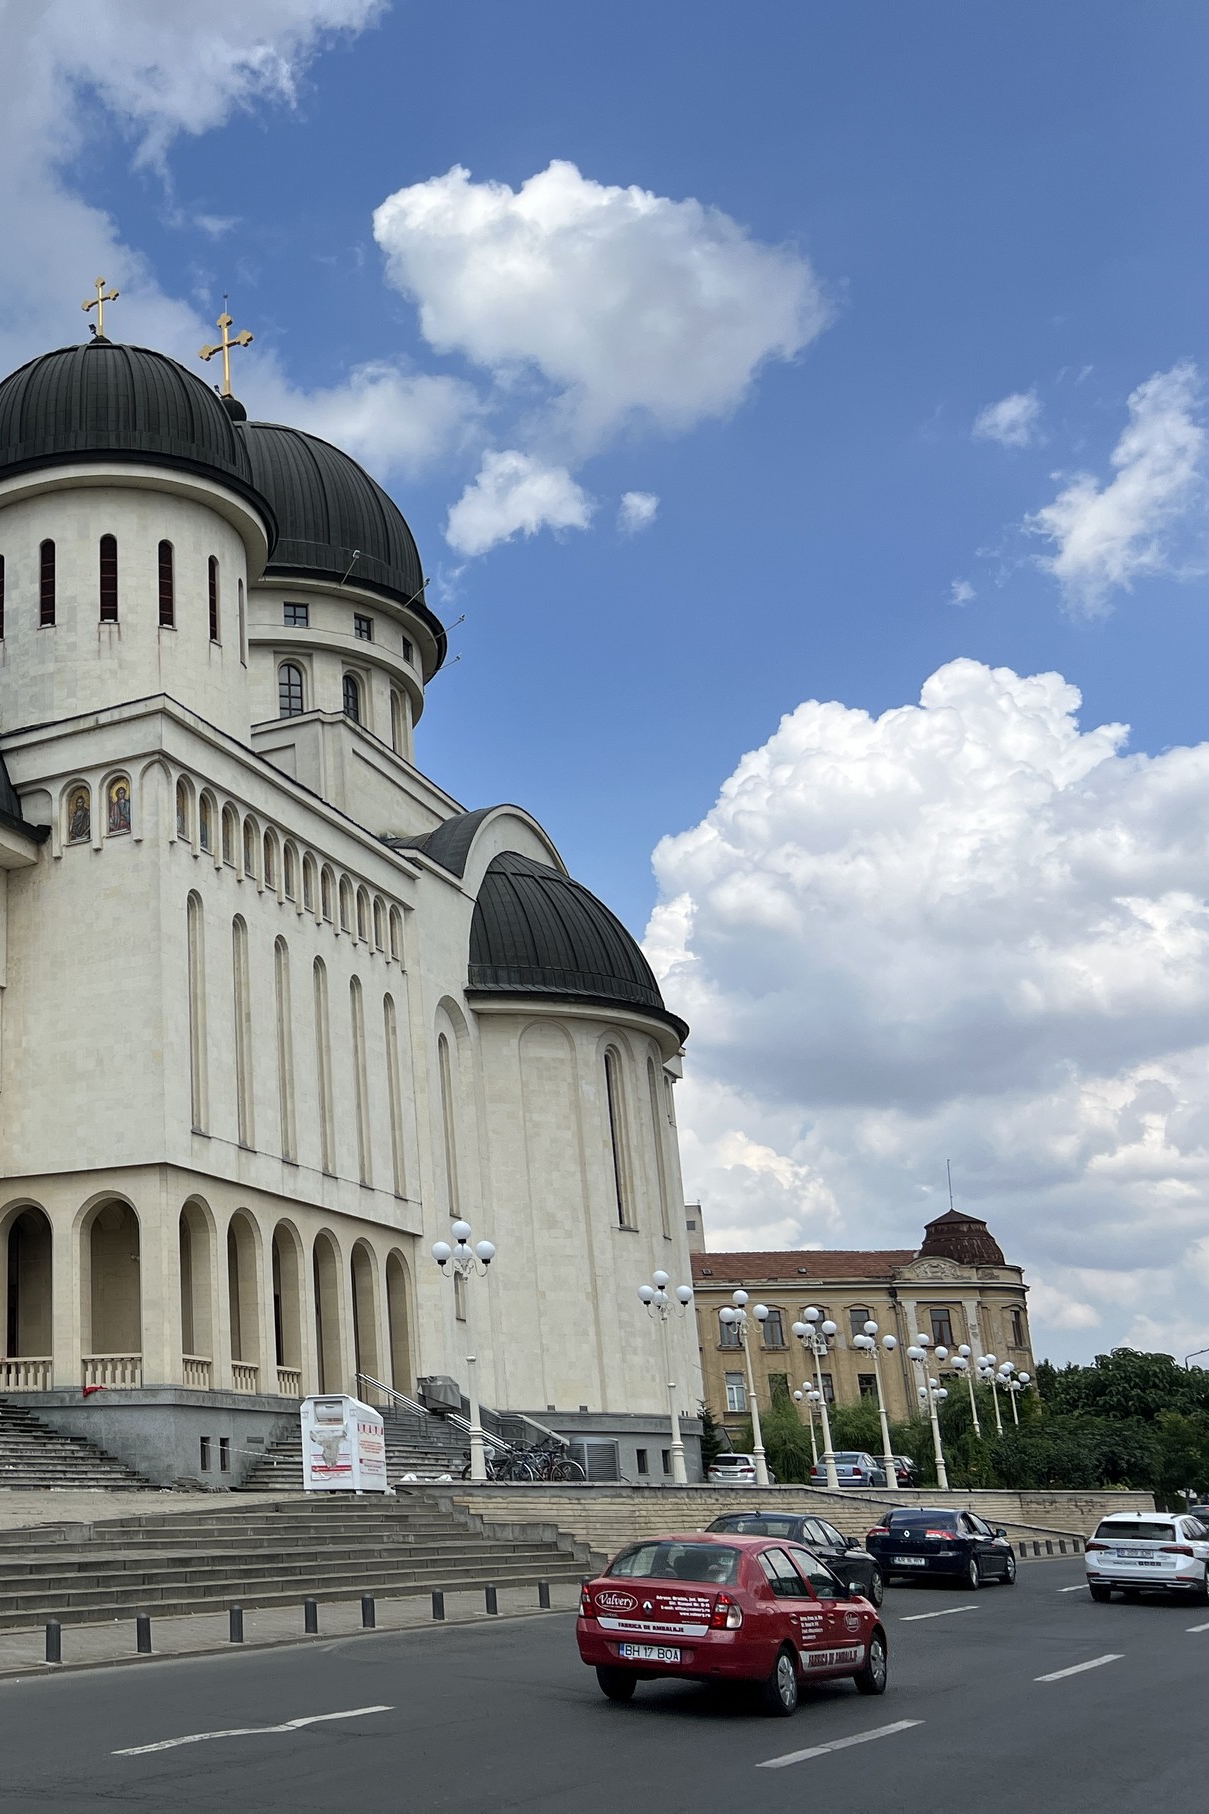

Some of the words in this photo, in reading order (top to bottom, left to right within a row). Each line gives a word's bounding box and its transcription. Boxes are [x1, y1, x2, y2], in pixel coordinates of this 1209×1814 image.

[598, 1593, 633, 1610] Valvery
[618, 1622, 642, 1630] FABRICA
[652, 1625, 684, 1633] AMBALAJE
[625, 1645, 640, 1657] BH
[644, 1647, 653, 1657] 17
[657, 1648, 679, 1660] BOA
